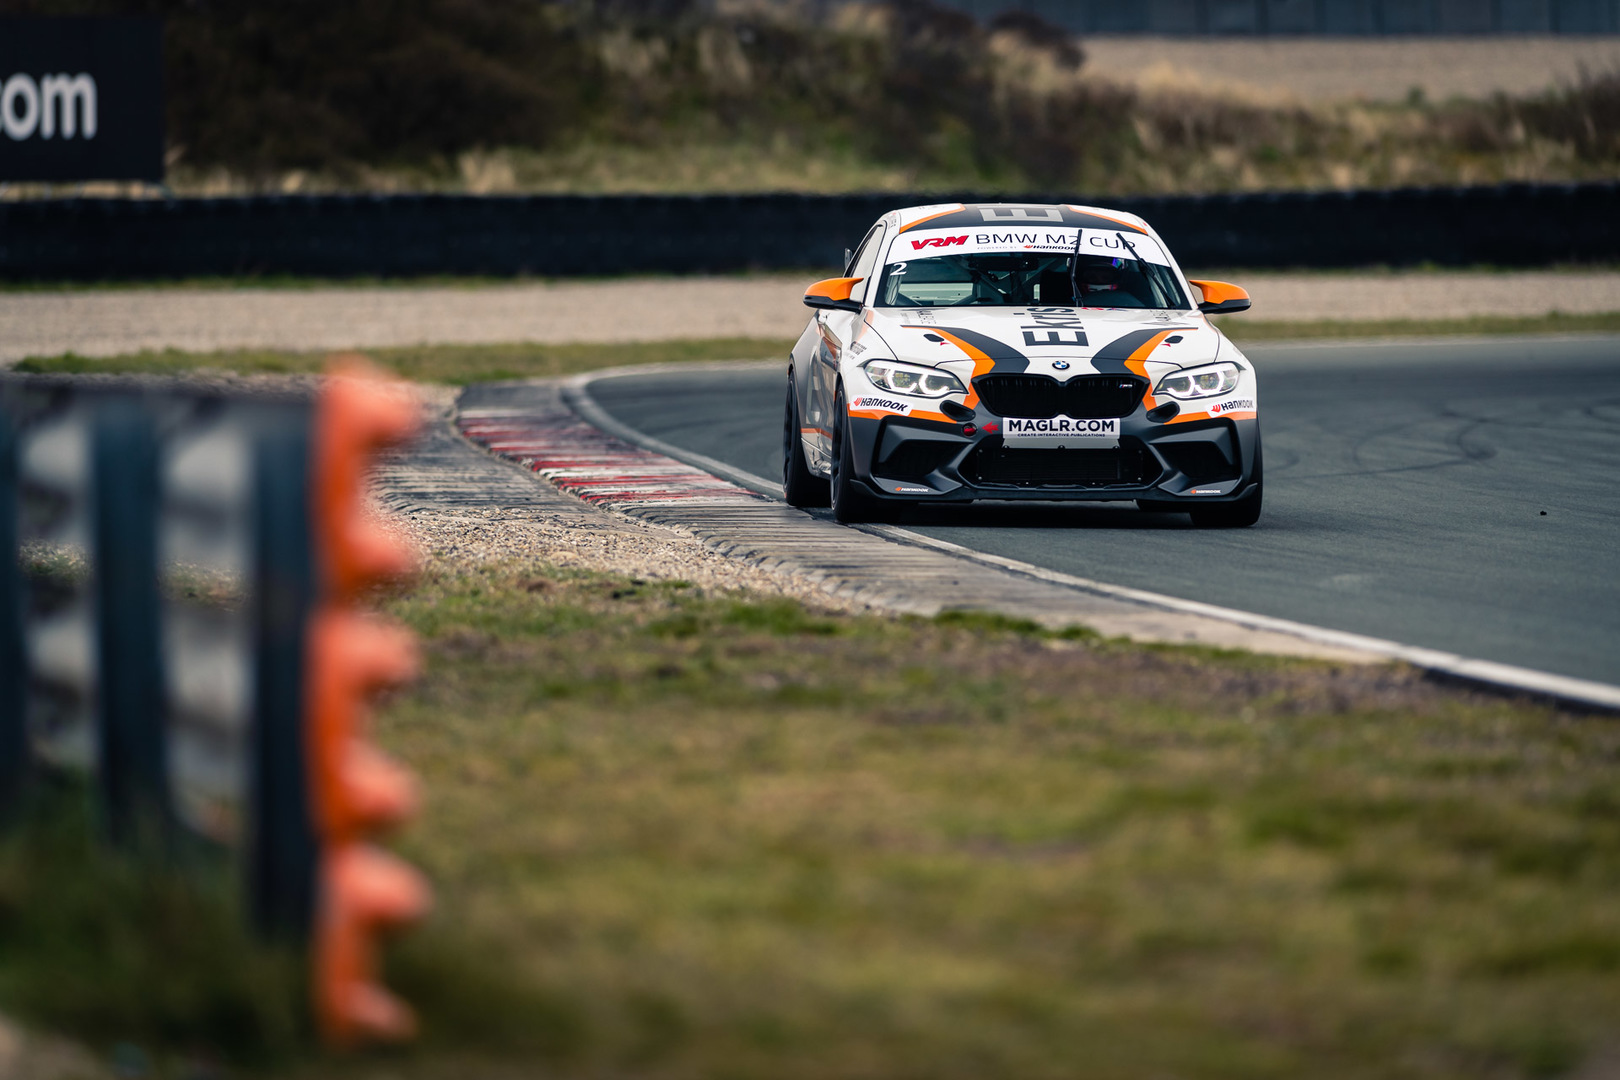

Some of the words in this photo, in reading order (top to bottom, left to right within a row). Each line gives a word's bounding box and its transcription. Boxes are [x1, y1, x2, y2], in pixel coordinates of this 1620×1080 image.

[0, 72, 98, 141] om
[911, 235, 969, 250] VRM
[976, 233, 1037, 244] BMW
[1046, 233, 1081, 246] M2
[1089, 236, 1136, 250] CUP
[889, 262, 907, 276] 2
[1008, 419, 1115, 432] MAGLR.COM
